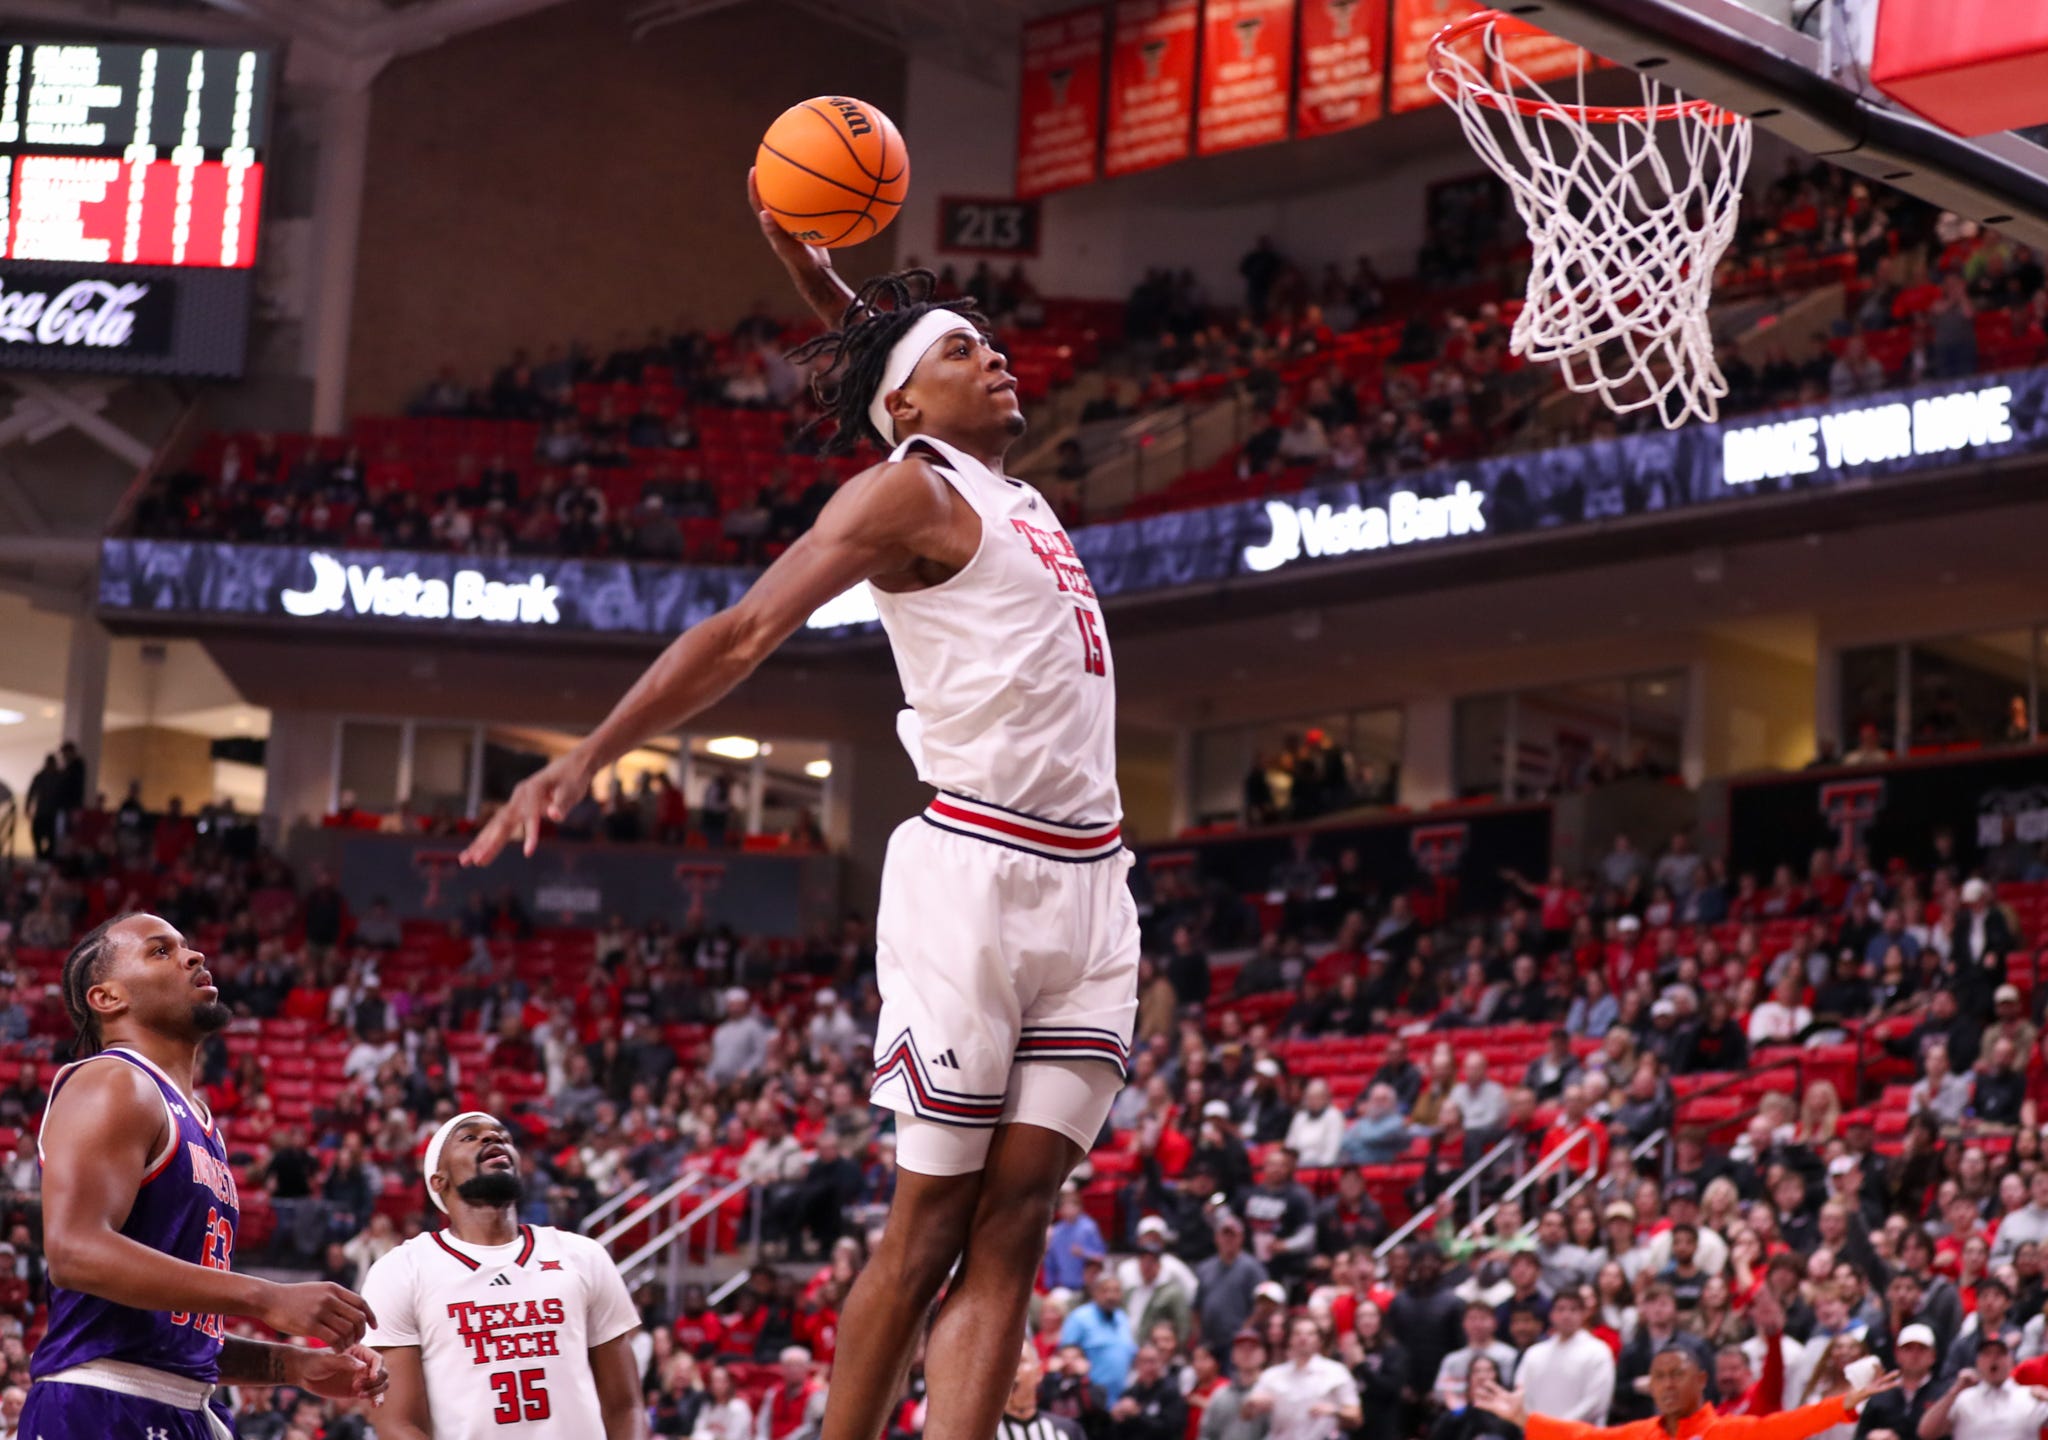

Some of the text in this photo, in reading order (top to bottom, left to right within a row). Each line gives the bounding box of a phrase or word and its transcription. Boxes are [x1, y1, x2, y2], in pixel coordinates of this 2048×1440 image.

[957, 205, 1021, 248] 213
[1723, 385, 2012, 485] MAKE YOUR MOVE
[1298, 480, 1486, 557] Vista Bank
[347, 565, 561, 624] Vista Bank
[1074, 606, 1106, 677] 15
[201, 1206, 234, 1272] 23
[447, 1298, 565, 1336] TEXAS
[463, 1330, 560, 1365] TECH
[490, 1367, 551, 1425] 35
